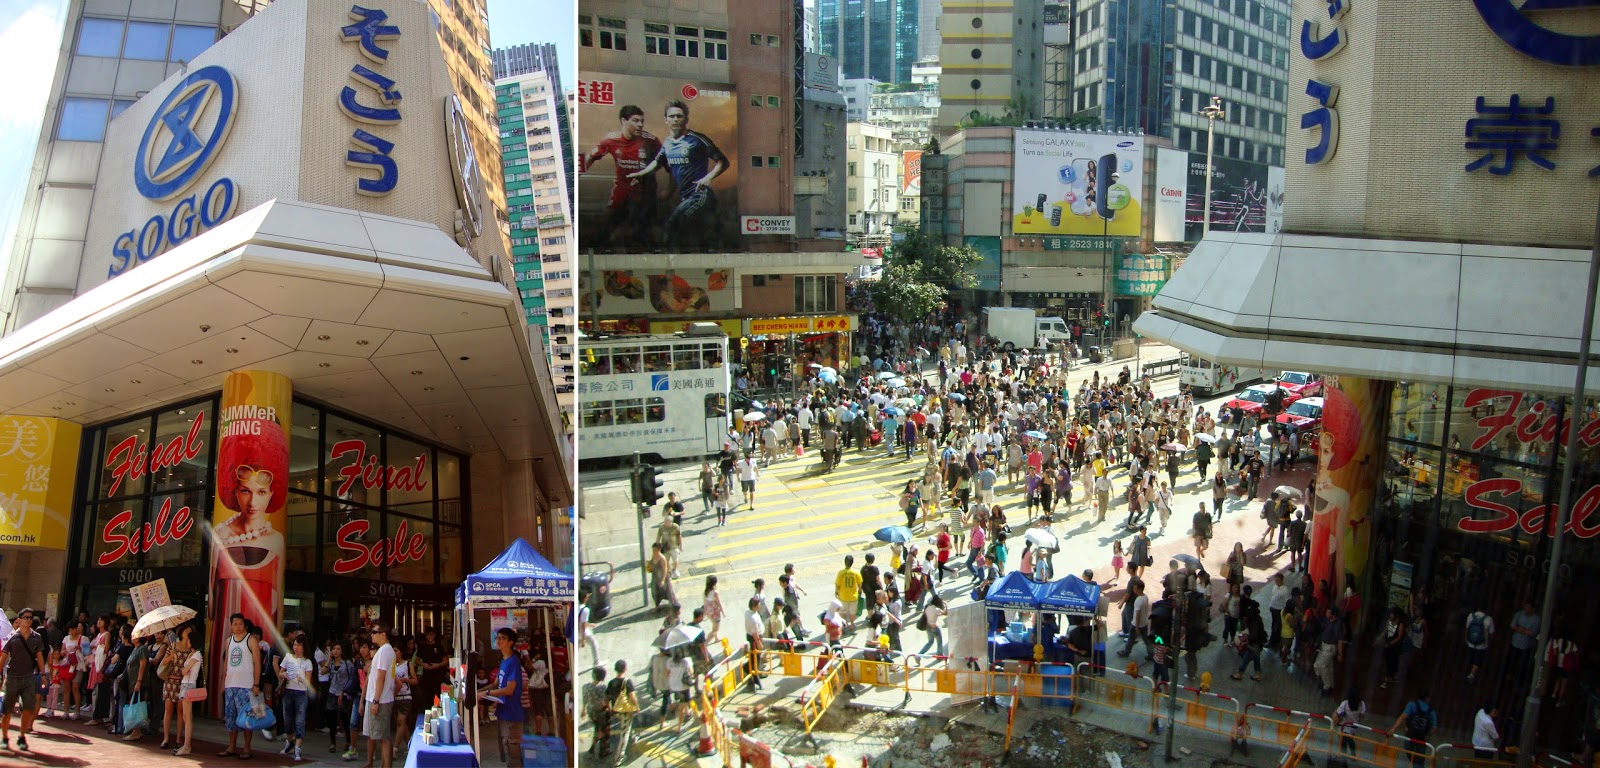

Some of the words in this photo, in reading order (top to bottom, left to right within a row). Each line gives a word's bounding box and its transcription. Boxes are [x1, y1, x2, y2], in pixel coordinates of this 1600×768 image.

[340, 4, 402, 197] そごう
[1465, 93, 1600, 177] 崇
[1046, 139, 1075, 147] GALAXY
[1063, 150, 1073, 158] Life
[1161, 187, 1182, 197] Canon
[109, 177, 239, 278] SOGO
[760, 219, 790, 227] CONVEY
[1070, 240, 1091, 248] 2523
[766, 323, 787, 331] CHENG
[0, 420, 39, 458] 美
[106, 410, 204, 498] Final
[331, 439, 428, 496] Final
[99, 497, 194, 566] Sale
[334, 519, 427, 574] Sale
[120, 569, 153, 583] SOGO
[845, 576, 854, 588] 10
[370, 583, 404, 596] SOGO
[511, 586, 549, 596] Charity
